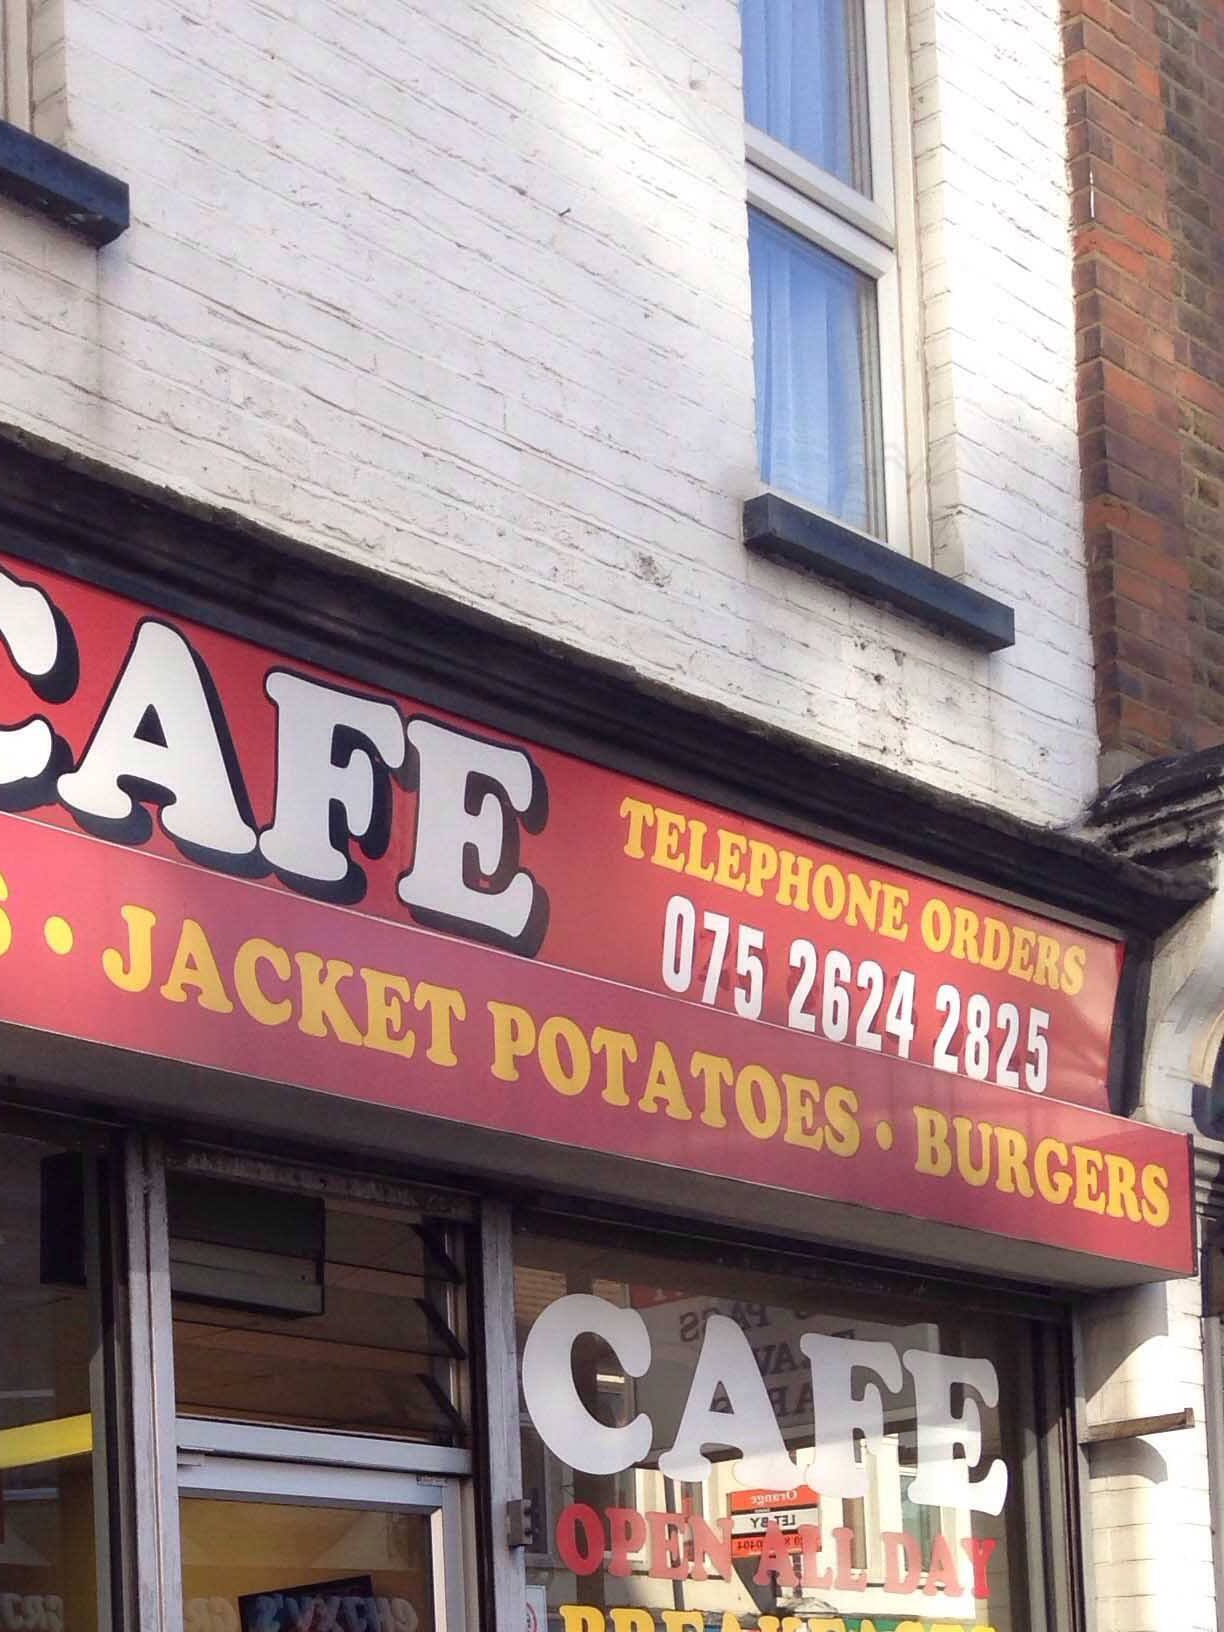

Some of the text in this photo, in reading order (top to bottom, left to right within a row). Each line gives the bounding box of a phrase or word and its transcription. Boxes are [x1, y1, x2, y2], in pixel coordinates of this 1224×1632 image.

[619, 797, 1087, 996] TELEPHONE ORDERS
[662, 895, 1051, 1094] 075 2624 2825
[102, 905, 467, 1067] JACKET
[487, 1001, 861, 1158] POTATOES
[912, 1105, 1171, 1227] BURGERS
[522, 1294, 1007, 1517] CAFE
[556, 1503, 999, 1600] OPEN ALL DAY
